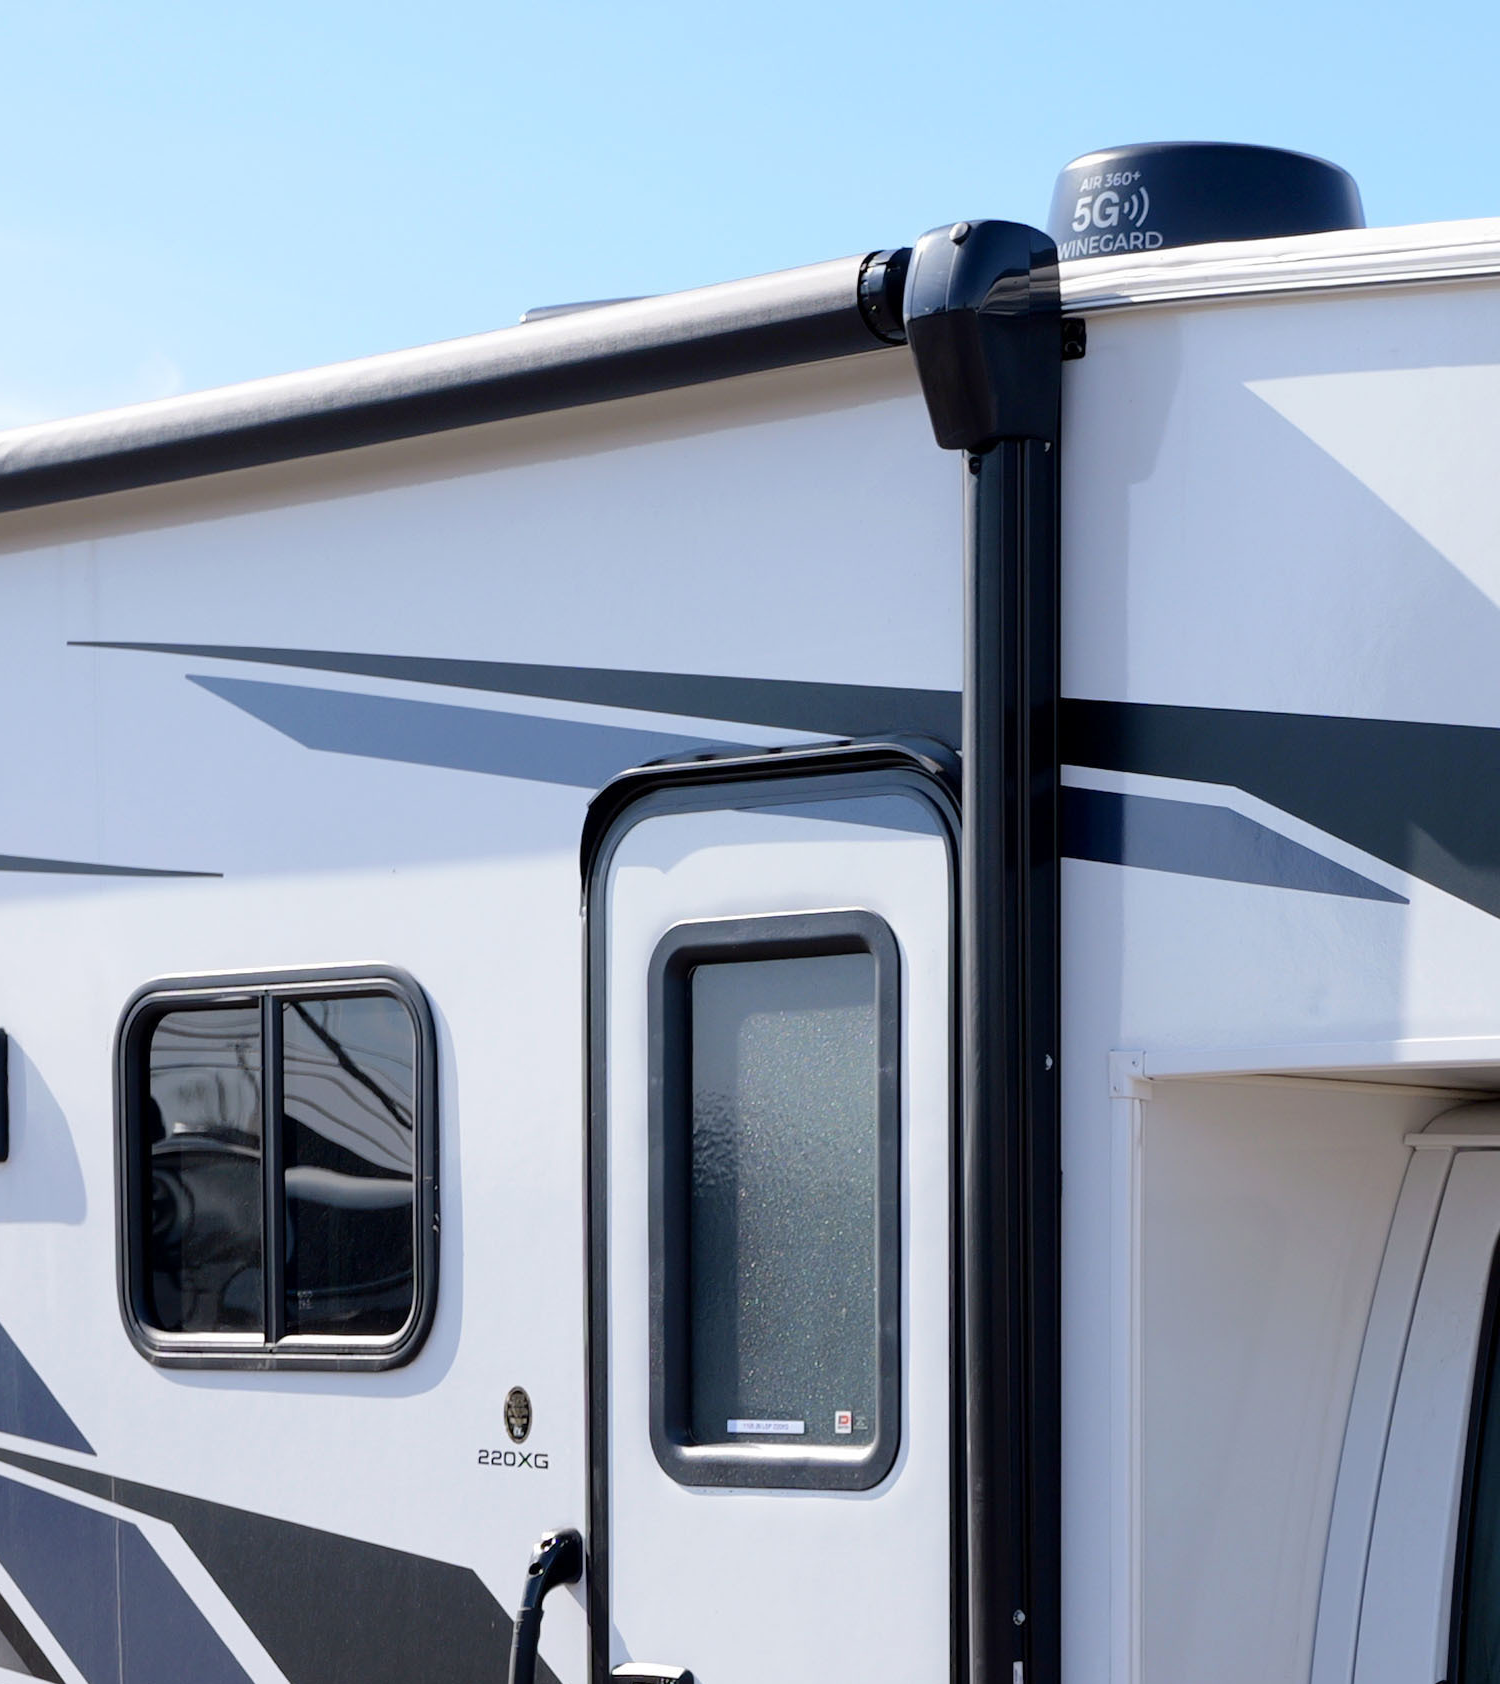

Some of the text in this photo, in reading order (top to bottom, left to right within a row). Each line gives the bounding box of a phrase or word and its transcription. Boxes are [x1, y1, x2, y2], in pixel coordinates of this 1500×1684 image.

[1080, 171, 1141, 191] AIR 360+
[1072, 191, 1119, 232] 5G
[1058, 231, 1163, 260] WINEGARD
[477, 1448, 549, 1470] 220XG
